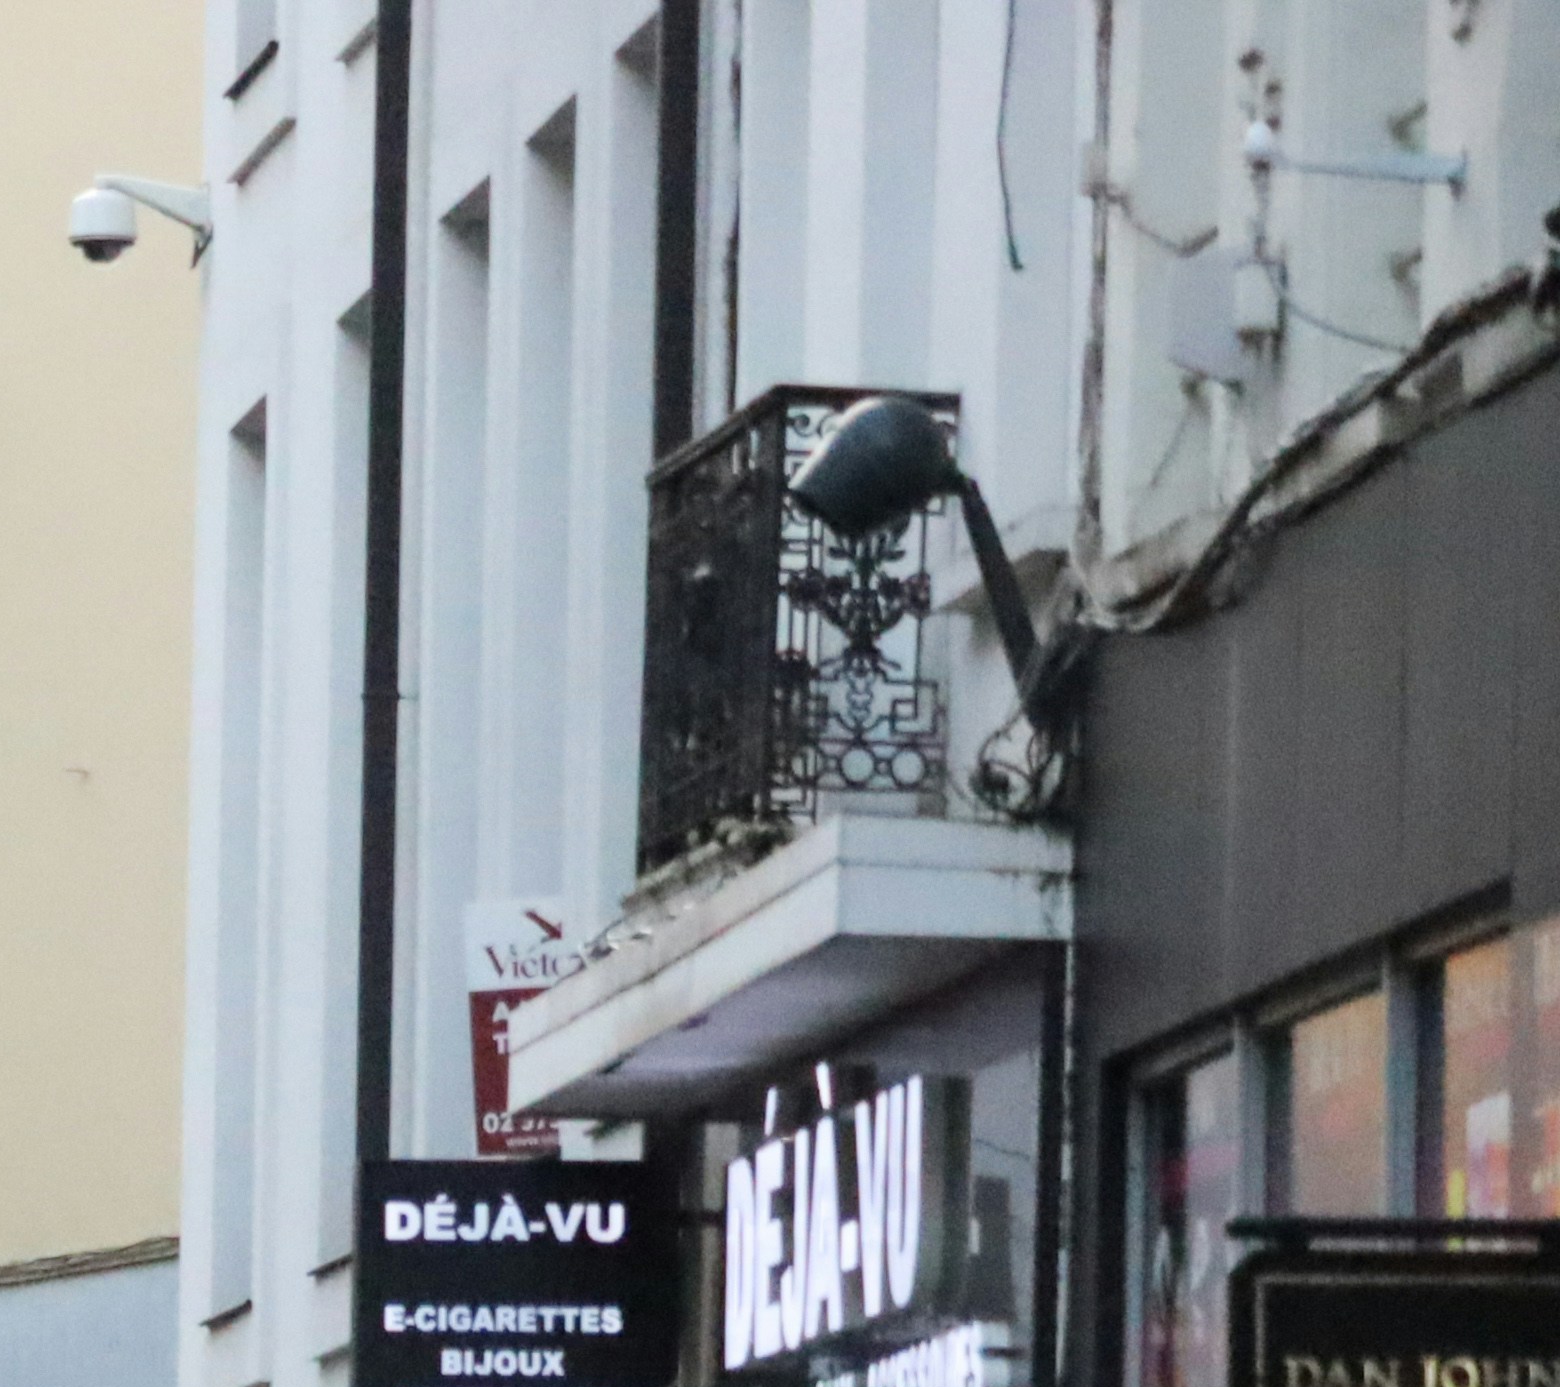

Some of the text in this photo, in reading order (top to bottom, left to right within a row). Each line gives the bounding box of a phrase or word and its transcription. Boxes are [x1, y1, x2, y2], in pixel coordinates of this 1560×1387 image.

[383, 1194, 626, 1243] DÉJÀ-VU
[724, 1061, 922, 1371] DÉJÀ-VU
[383, 1304, 624, 1335] E-CIGARETTES
[440, 1348, 566, 1378] BIJOUX
